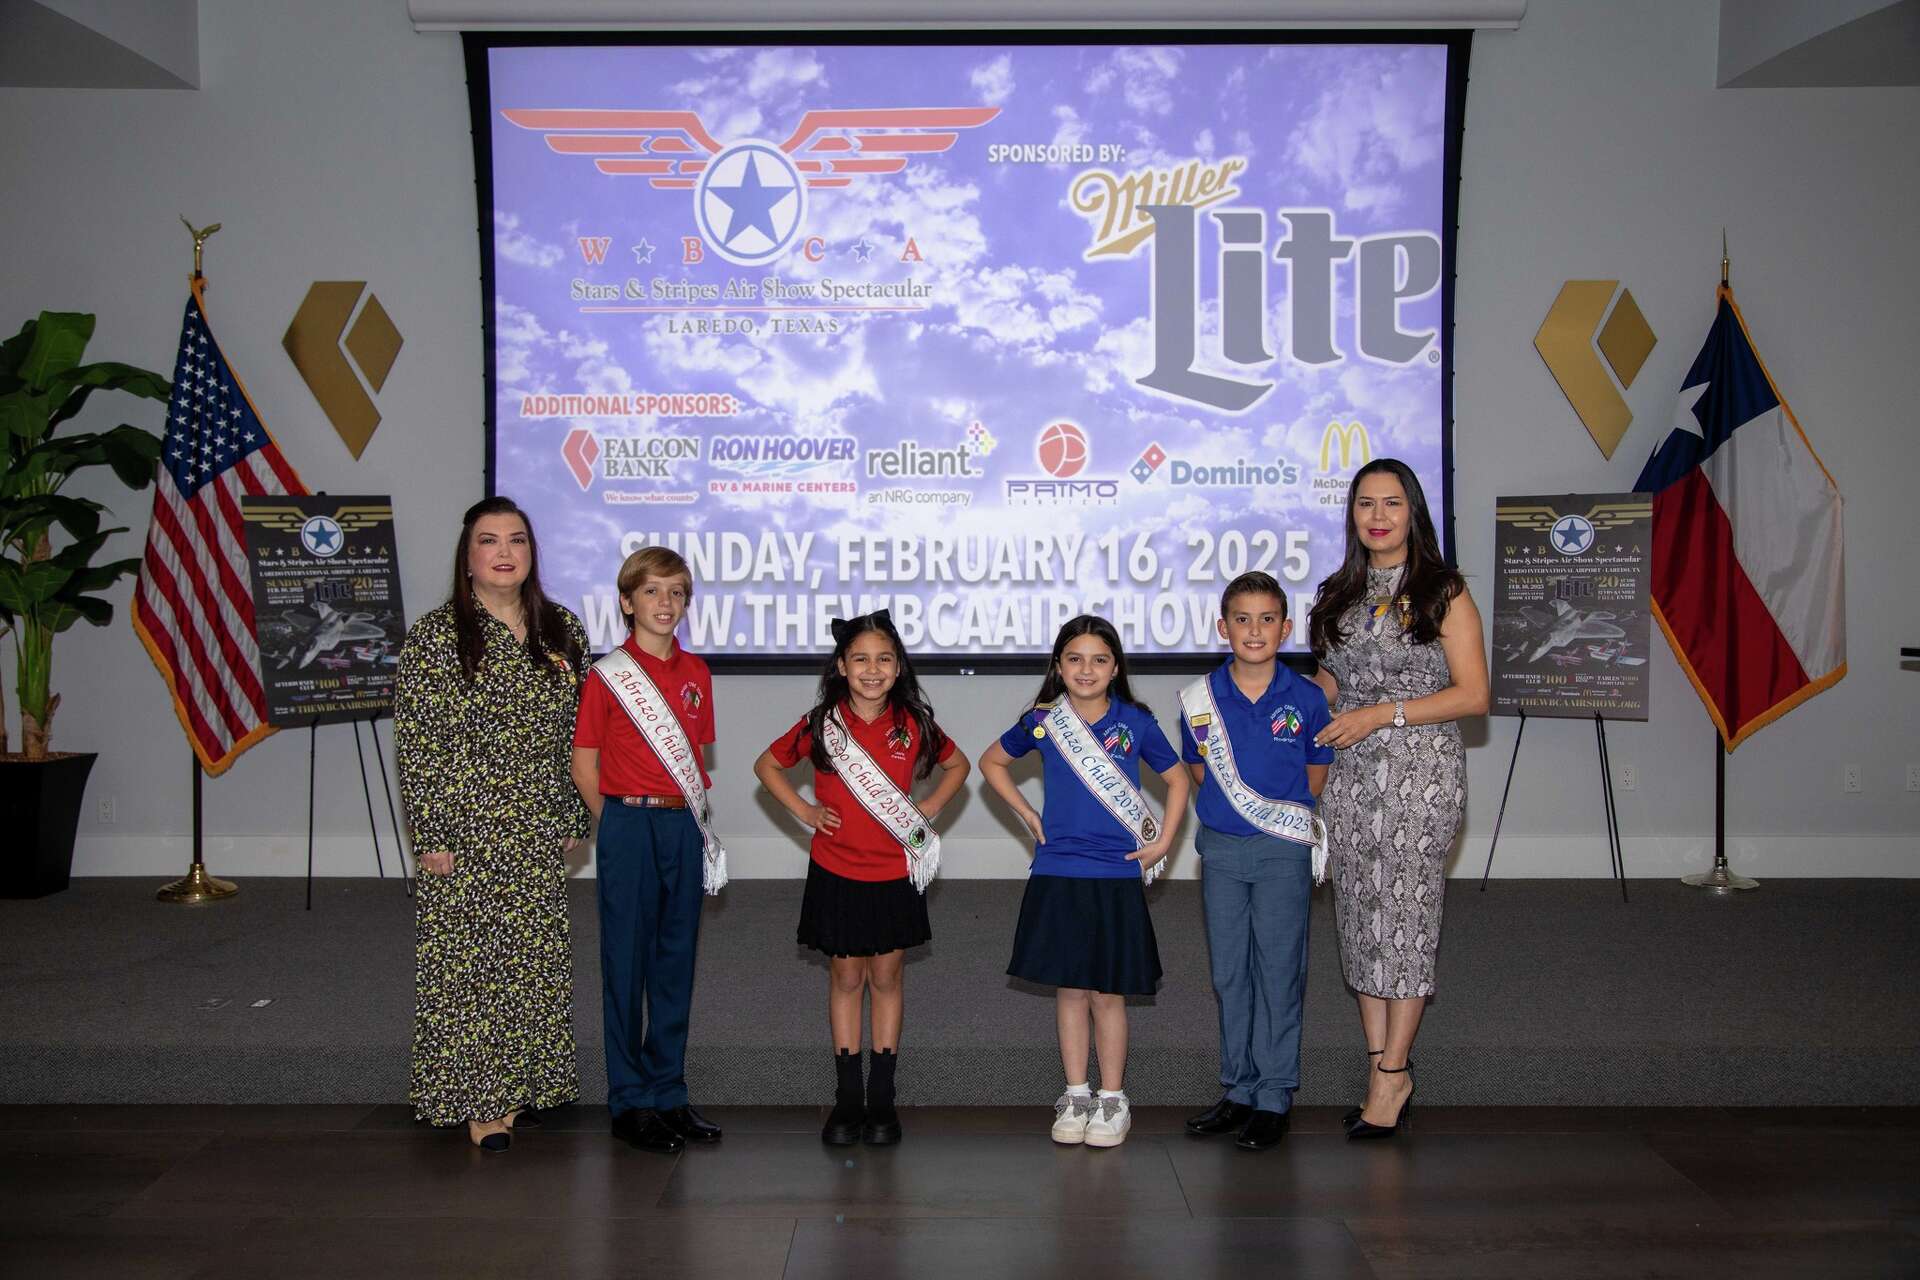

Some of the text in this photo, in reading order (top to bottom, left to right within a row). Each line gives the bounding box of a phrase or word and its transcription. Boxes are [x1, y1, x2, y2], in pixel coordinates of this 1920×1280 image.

[988, 144, 1126, 162] SPONSORED BY:
[1072, 160, 1245, 252] Miller
[580, 238, 923, 264] W B C A
[571, 277, 933, 302] Stars & Stripes Air Show Spectacular
[668, 318, 839, 335] LAREDO, TEXAS
[523, 396, 738, 415] ADDITIONAL SPONSORS:
[604, 439, 699, 458] FALCON
[711, 438, 856, 461] RON HOOVER
[868, 443, 971, 476] reliant
[605, 460, 670, 477] BANK
[1171, 458, 1298, 485] Domino's
[710, 482, 857, 492] RV & MARINE CENTERS
[1007, 480, 1118, 498] PATMO
[1313, 478, 1351, 489] McDon
[868, 490, 971, 505] an NRG company
[839, 531, 1085, 582] FEBRUARY
[1100, 531, 1171, 588] 16,
[1188, 530, 1310, 581] 2025
[1532, 557, 1559, 565] Stripes
[1595, 556, 1641, 564] Spectacular
[615, 671, 658, 722] Abrazo
[655, 724, 687, 763] Child
[823, 716, 850, 761] brazo
[848, 763, 887, 799] Child
[879, 797, 914, 829] 2025
[1051, 704, 1083, 754] Abrazo
[1081, 756, 1121, 791] Child
[1112, 790, 1144, 821] 2025
[1205, 735, 1309, 832] Abrazo Child 2025
